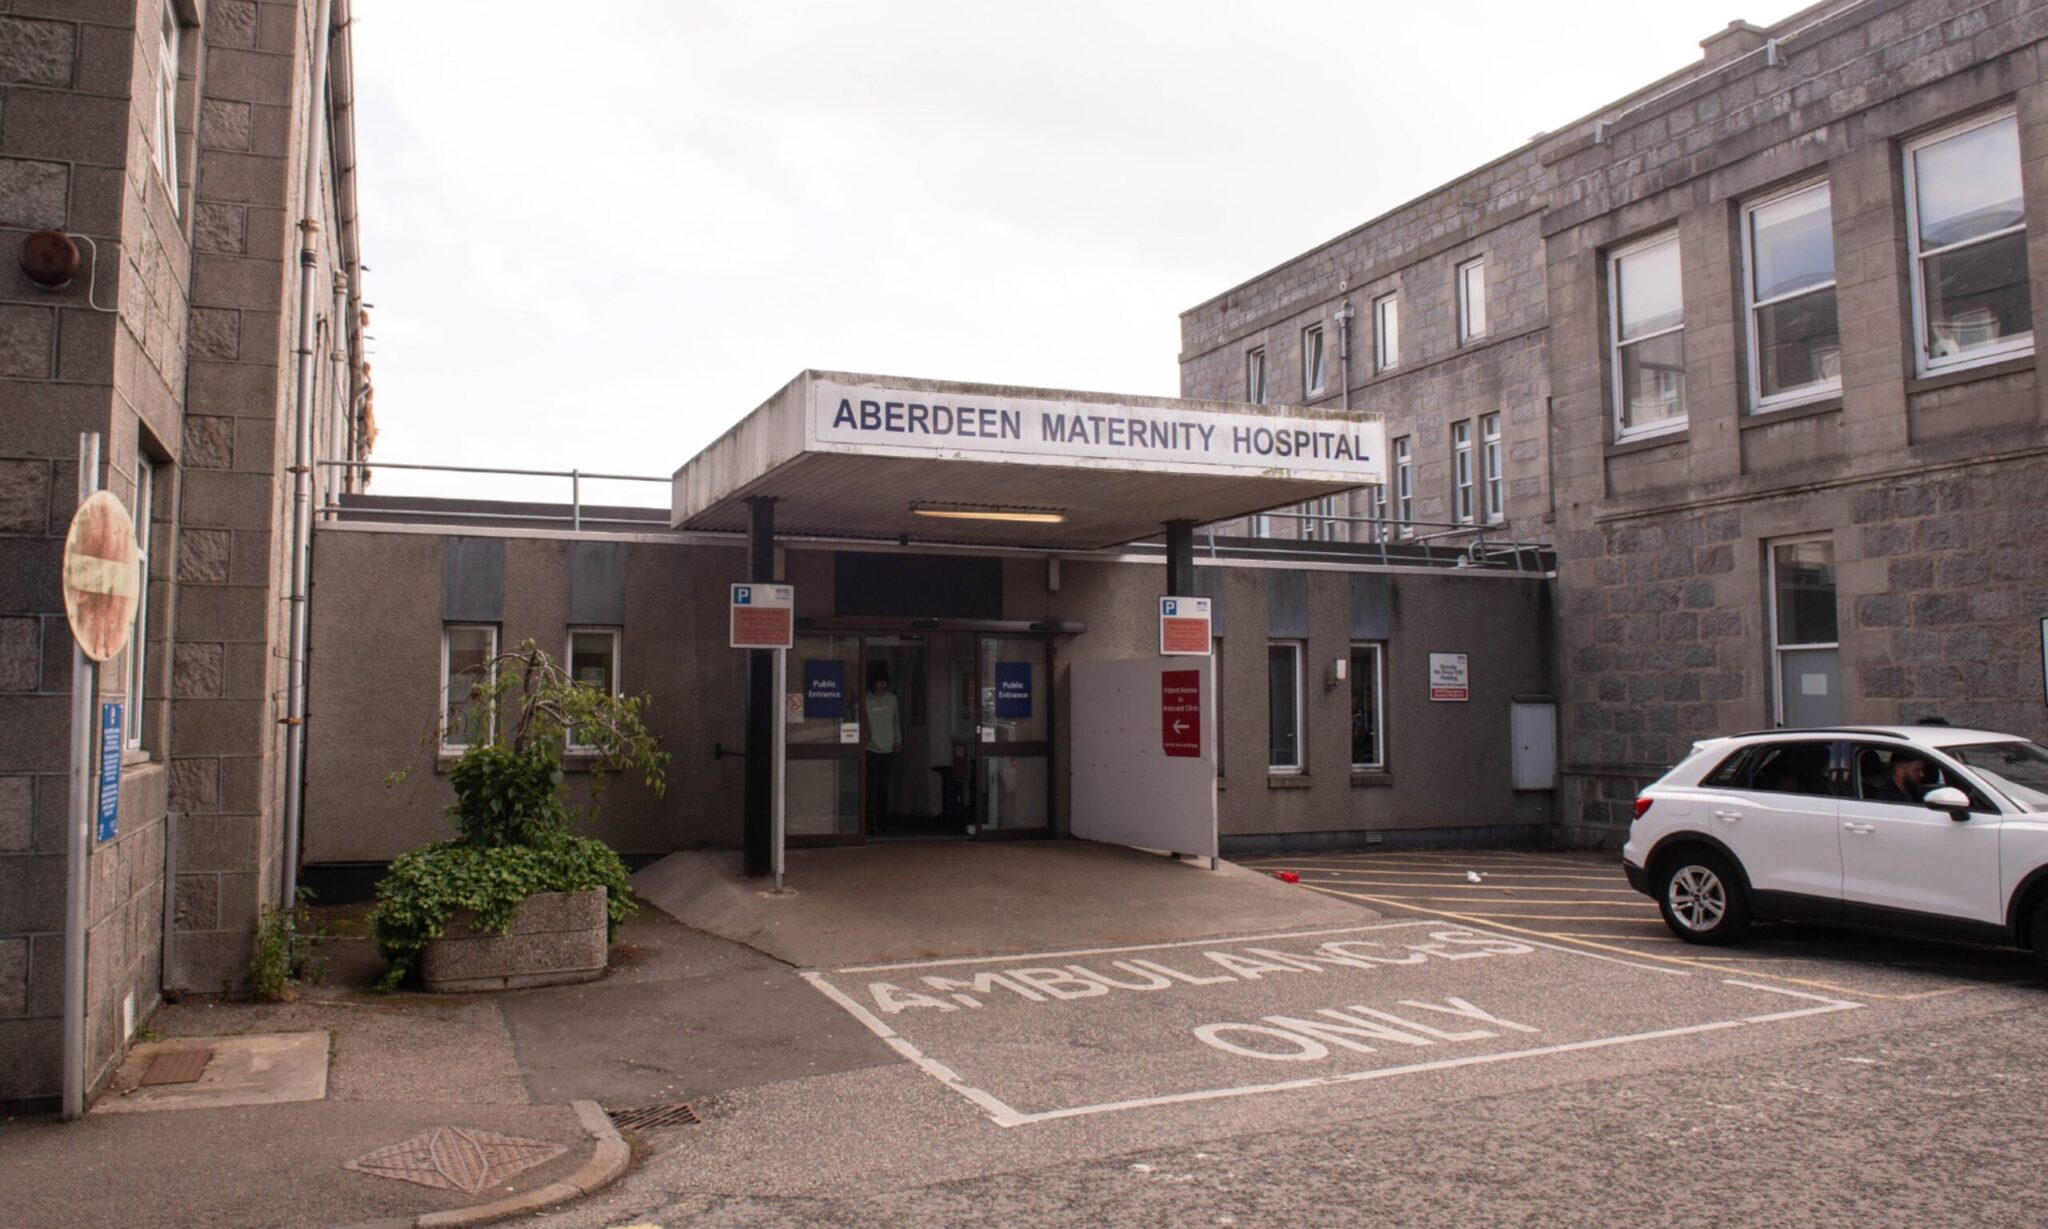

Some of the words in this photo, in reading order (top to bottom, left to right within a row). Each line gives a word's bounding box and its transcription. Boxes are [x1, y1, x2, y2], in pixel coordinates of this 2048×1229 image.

[833, 398, 1021, 440] ABERDEEN
[1041, 413, 1216, 451] MATERNITY
[1232, 426, 1370, 461] HOSPITAL
[738, 588, 749, 603] P
[1165, 601, 1175, 614] P
[813, 680, 837, 688] Public
[1002, 681, 1024, 689] Public
[808, 690, 841, 698] Entrance
[998, 691, 1028, 699] Entrance
[868, 931, 1534, 1015] AMBULANCES
[1193, 997, 1541, 1063] ONLY
